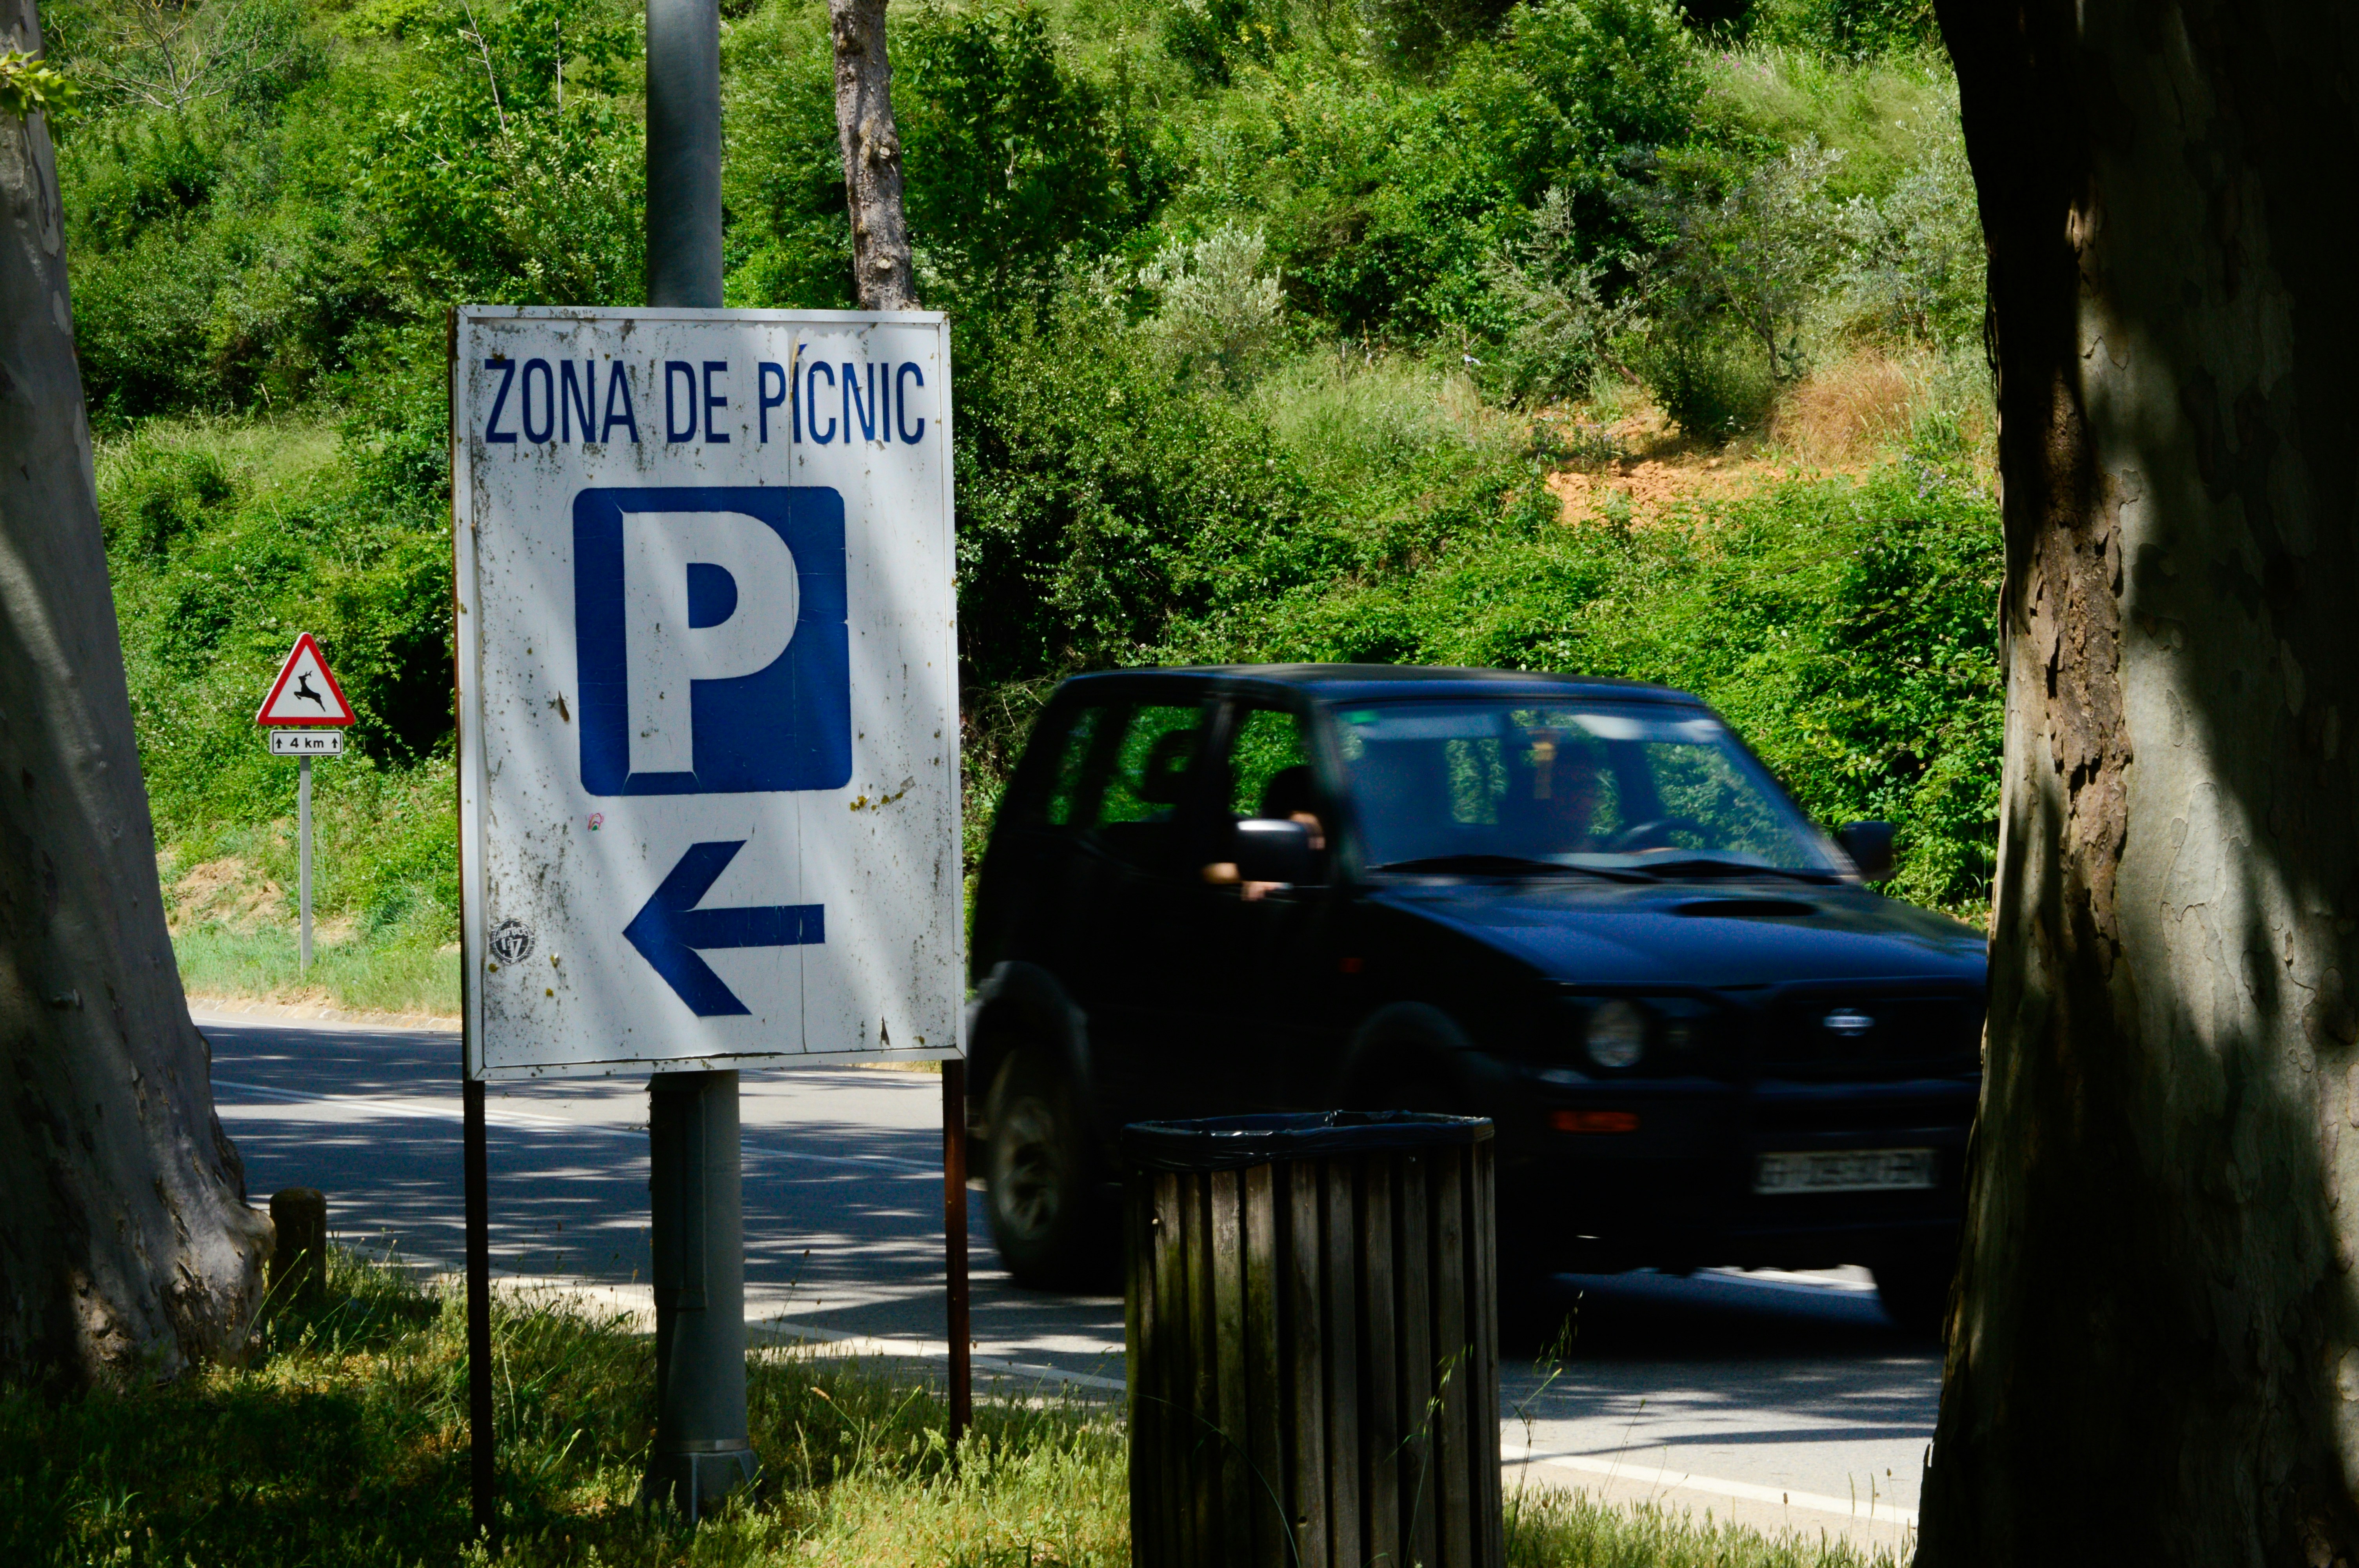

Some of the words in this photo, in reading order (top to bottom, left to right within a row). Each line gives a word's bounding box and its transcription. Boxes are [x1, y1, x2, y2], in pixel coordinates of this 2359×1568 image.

[485, 358, 639, 444] ZONA
[665, 360, 731, 444] DE
[758, 344, 925, 445] PÍCNIC
[622, 511, 800, 774] P
[290, 737, 299, 748] 4
[305, 737, 324, 748] km
